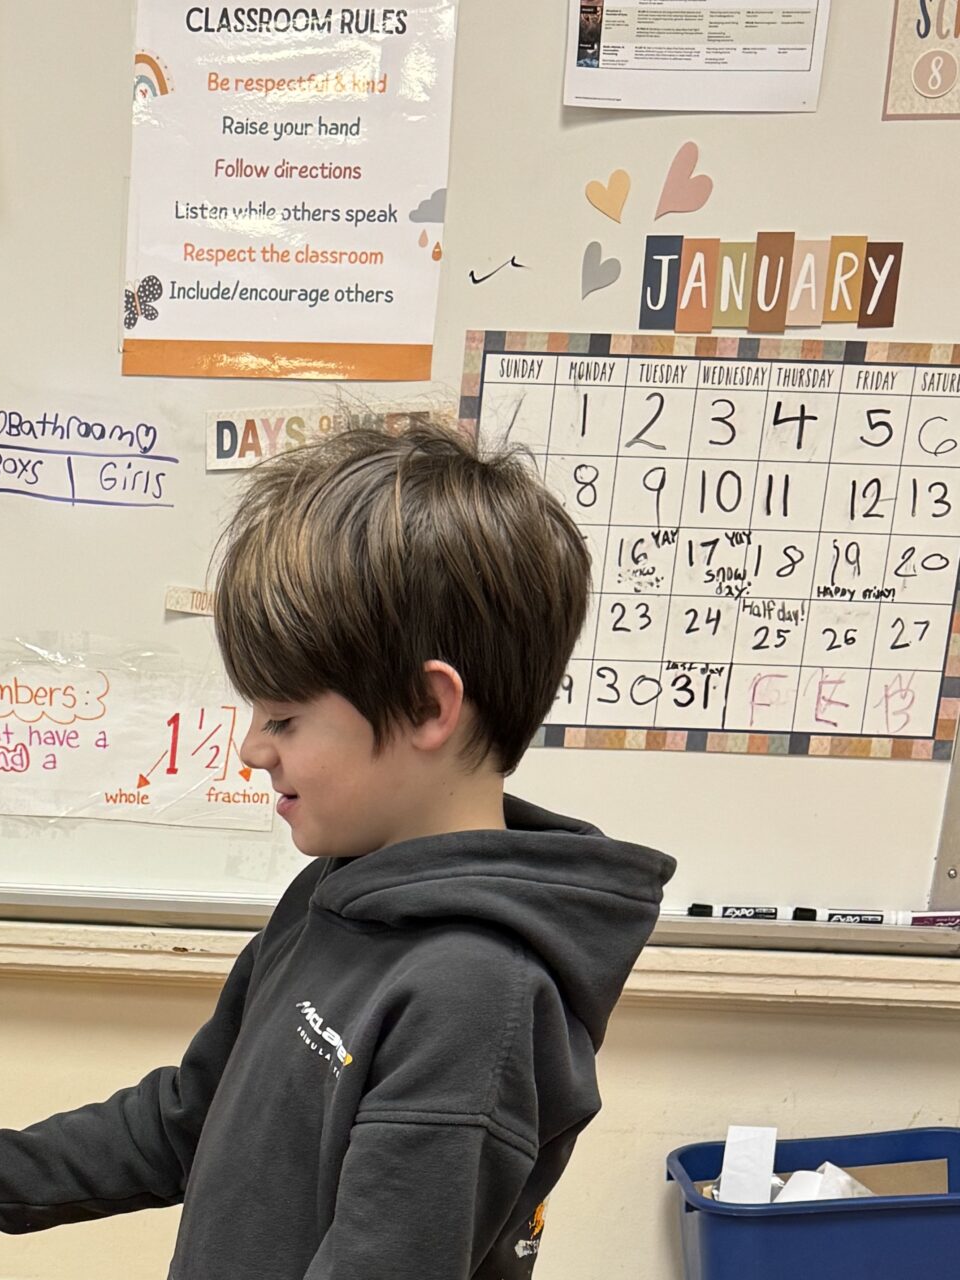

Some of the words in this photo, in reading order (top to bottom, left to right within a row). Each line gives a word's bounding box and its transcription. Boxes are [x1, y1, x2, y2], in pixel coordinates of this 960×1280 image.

[185, 7, 332, 34] CLASSROOM
[339, 9, 409, 35] RULES
[207, 72, 231, 92] Be
[235, 73, 329, 98] respectful
[351, 73, 388, 94] kind
[222, 115, 270, 136] Raise
[274, 120, 313, 141] your
[318, 115, 361, 137] hand
[214, 158, 270, 179] Follow
[274, 159, 363, 180] directions
[175, 200, 228, 220] Listen
[232, 201, 277, 221] while
[281, 201, 341, 223] others
[345, 202, 398, 228] speak
[183, 243, 257, 267] Respect
[261, 243, 291, 264] the
[295, 243, 384, 266] classroom
[168, 281, 330, 308] Include/encourage
[334, 282, 394, 304] others
[646, 251, 895, 316] JANUARY
[498, 358, 544, 380] SUNDAY
[568, 361, 616, 384] MONDAY
[639, 364, 688, 385] TUESDAY
[702, 365, 768, 387] WEDNESDAY
[775, 368, 835, 390] THURSDAY
[855, 371, 899, 392] FRIDAY
[5, 410, 136, 448] Bathroom
[216, 415, 307, 460] DAYS
[624, 391, 667, 451] 2
[709, 398, 737, 446] 3
[772, 400, 819, 450] 4
[860, 408, 895, 447] 5
[917, 415, 958, 457] 6
[99, 460, 167, 500] Girls
[573, 463, 600, 508] 8
[642, 466, 667, 530] 9
[699, 468, 742, 513] 10
[766, 473, 790, 517] 11
[850, 477, 886, 521] 12
[910, 477, 952, 518] 13
[618, 537, 649, 567] 16
[687, 537, 720, 567] 17
[754, 543, 805, 577] 18
[830, 538, 861, 587] 19
[893, 546, 950, 578] 20
[742, 598, 776, 622] Half
[777, 600, 807, 625] day!
[610, 602, 653, 633] 23
[685, 606, 722, 637] 24
[752, 626, 792, 650] 25
[822, 628, 857, 652] 26
[890, 617, 931, 650] 27
[596, 666, 663, 707] 30
[670, 673, 712, 710] 31
[27, 724, 81, 750] have
[93, 730, 110, 750] a
[42, 753, 58, 771] a
[103, 787, 151, 806] whole
[205, 785, 270, 806] fraction
[724, 906, 756, 919] EXPO
